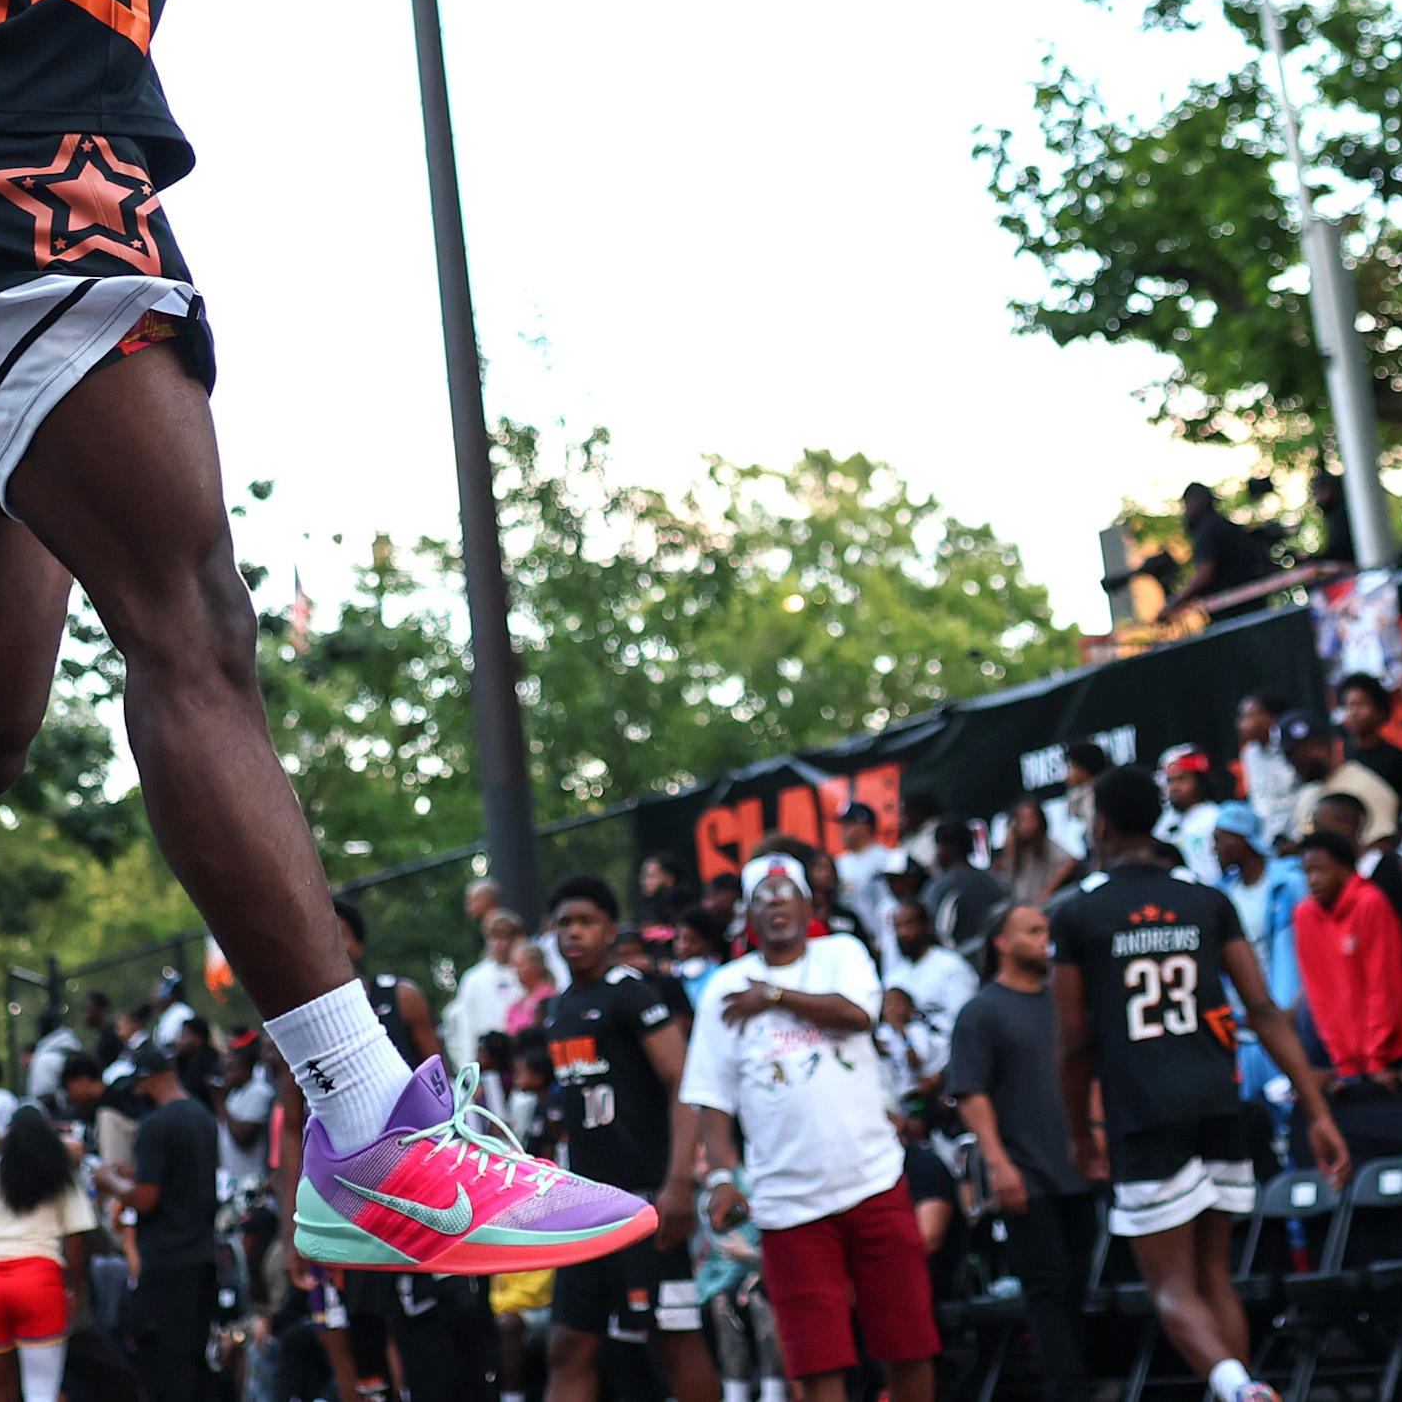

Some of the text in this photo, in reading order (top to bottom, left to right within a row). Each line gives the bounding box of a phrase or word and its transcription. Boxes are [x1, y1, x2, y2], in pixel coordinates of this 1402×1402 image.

[1111, 915, 1201, 959] ANDREWS
[1124, 953, 1200, 1042] 23
[581, 1083, 615, 1129] 10
